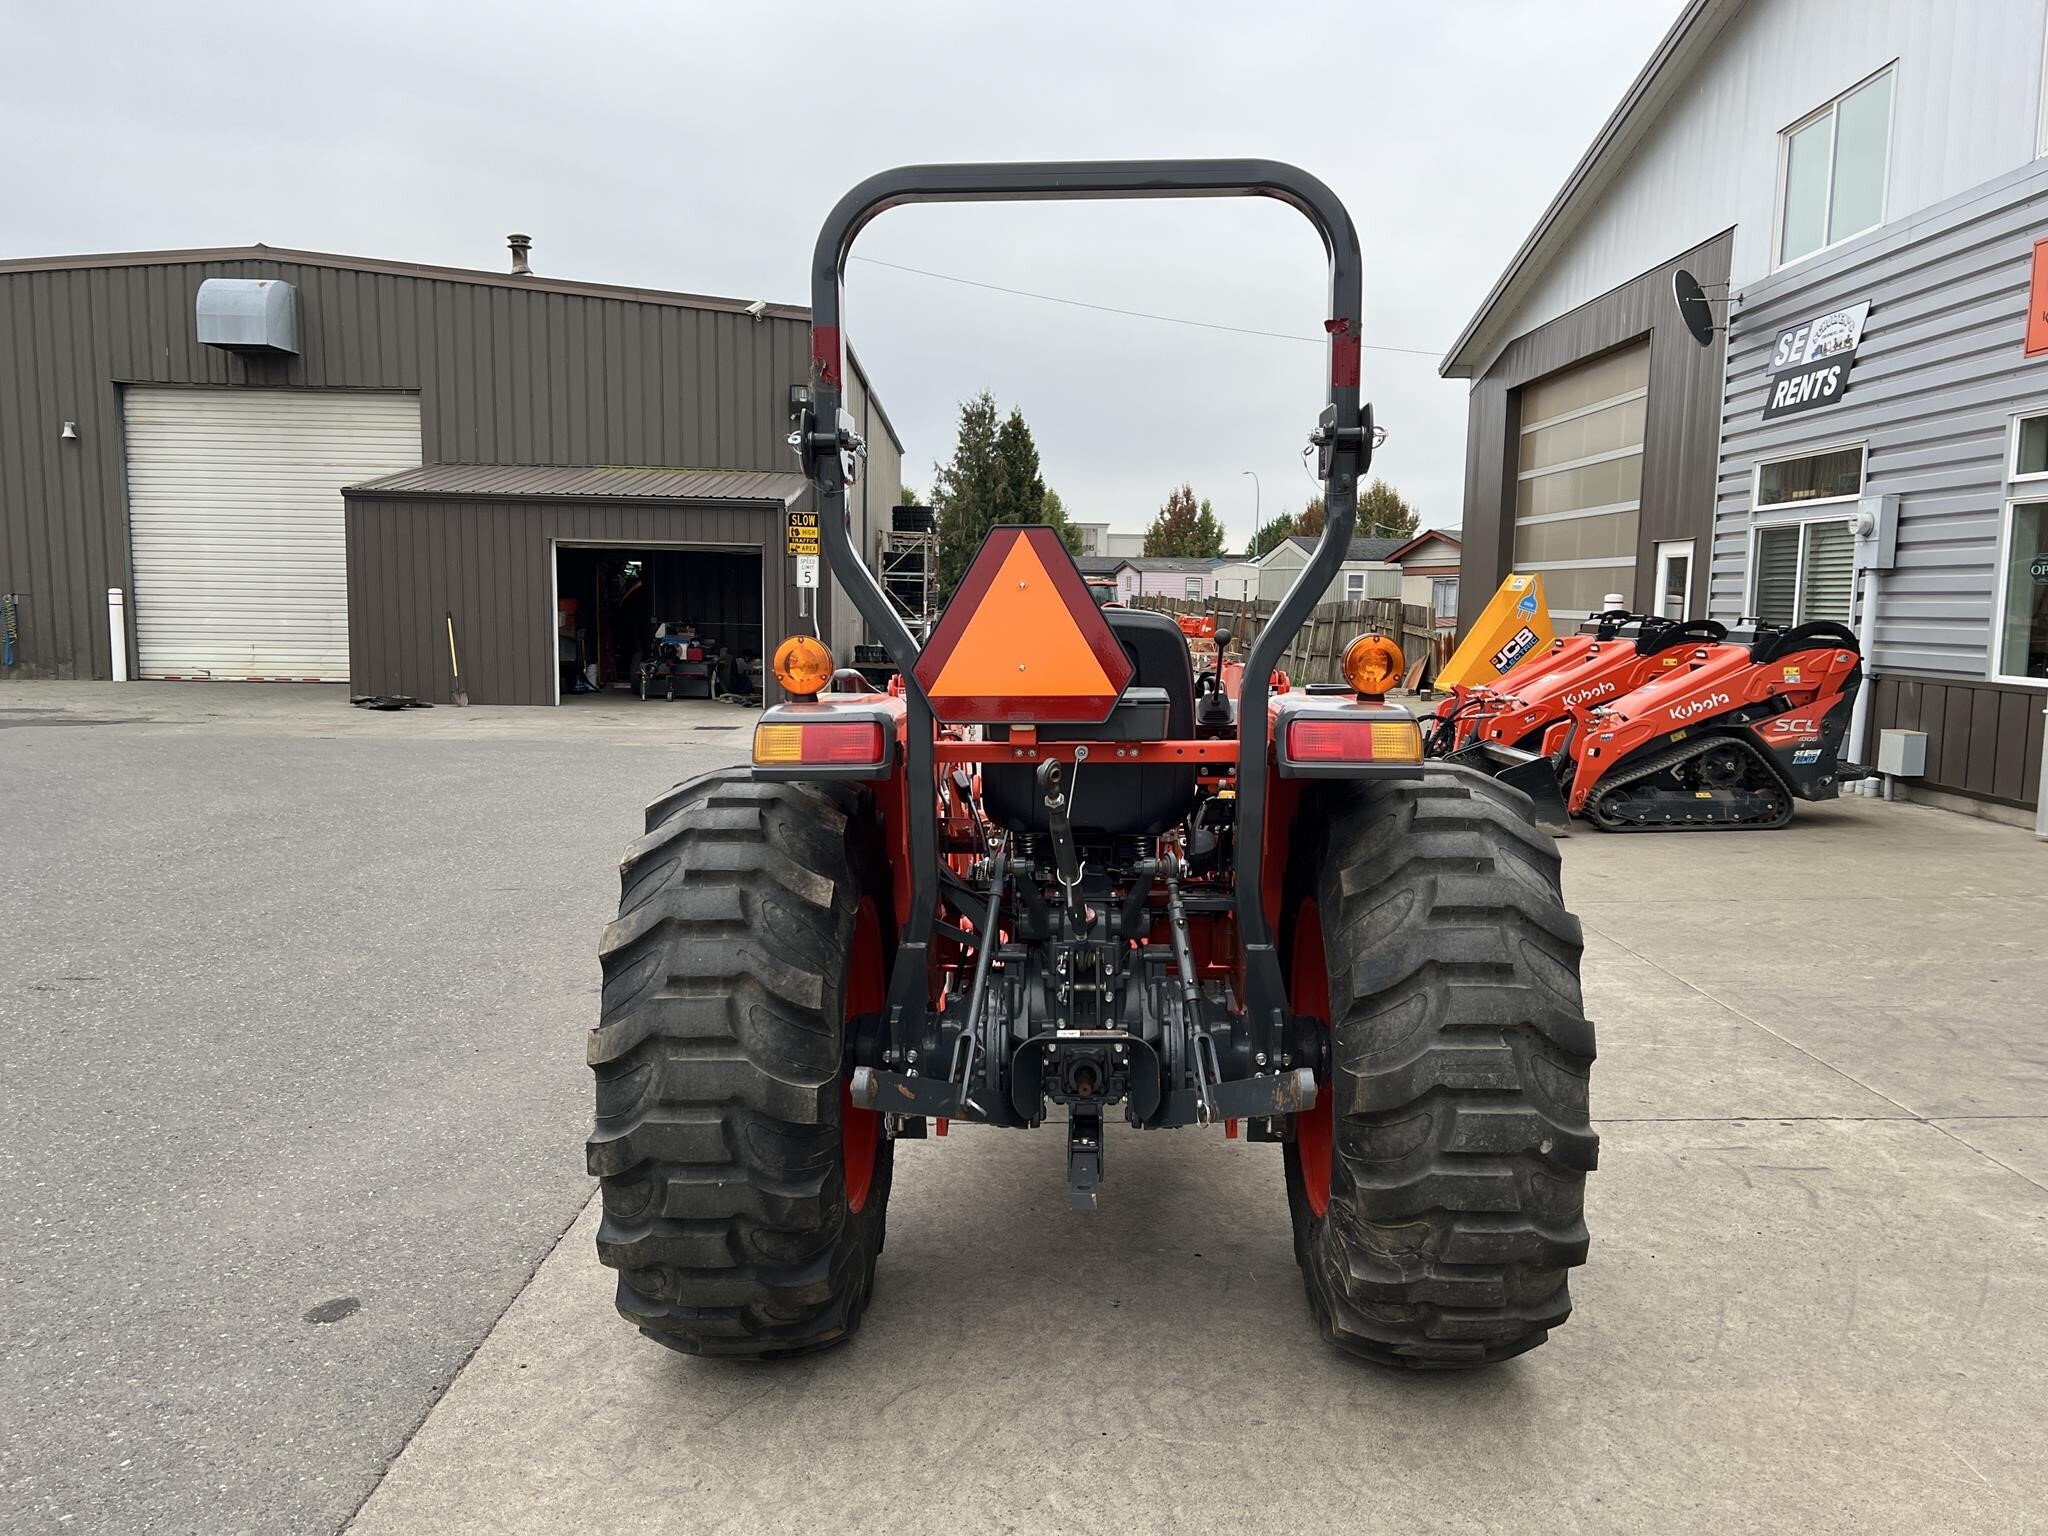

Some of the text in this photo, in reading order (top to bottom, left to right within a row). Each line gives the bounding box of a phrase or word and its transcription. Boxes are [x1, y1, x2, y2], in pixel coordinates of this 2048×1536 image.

[1774, 326, 1810, 367] SE
[1771, 365, 1841, 409] RENTS
[791, 514, 816, 526] SLOW
[804, 571, 812, 584] 5
[1495, 627, 1534, 669] JCB
[1500, 636, 1539, 674] ELECTRIC
[1562, 680, 1616, 705] Kubota
[1670, 692, 1730, 720] Kubota
[1773, 719, 1818, 733] SCL
